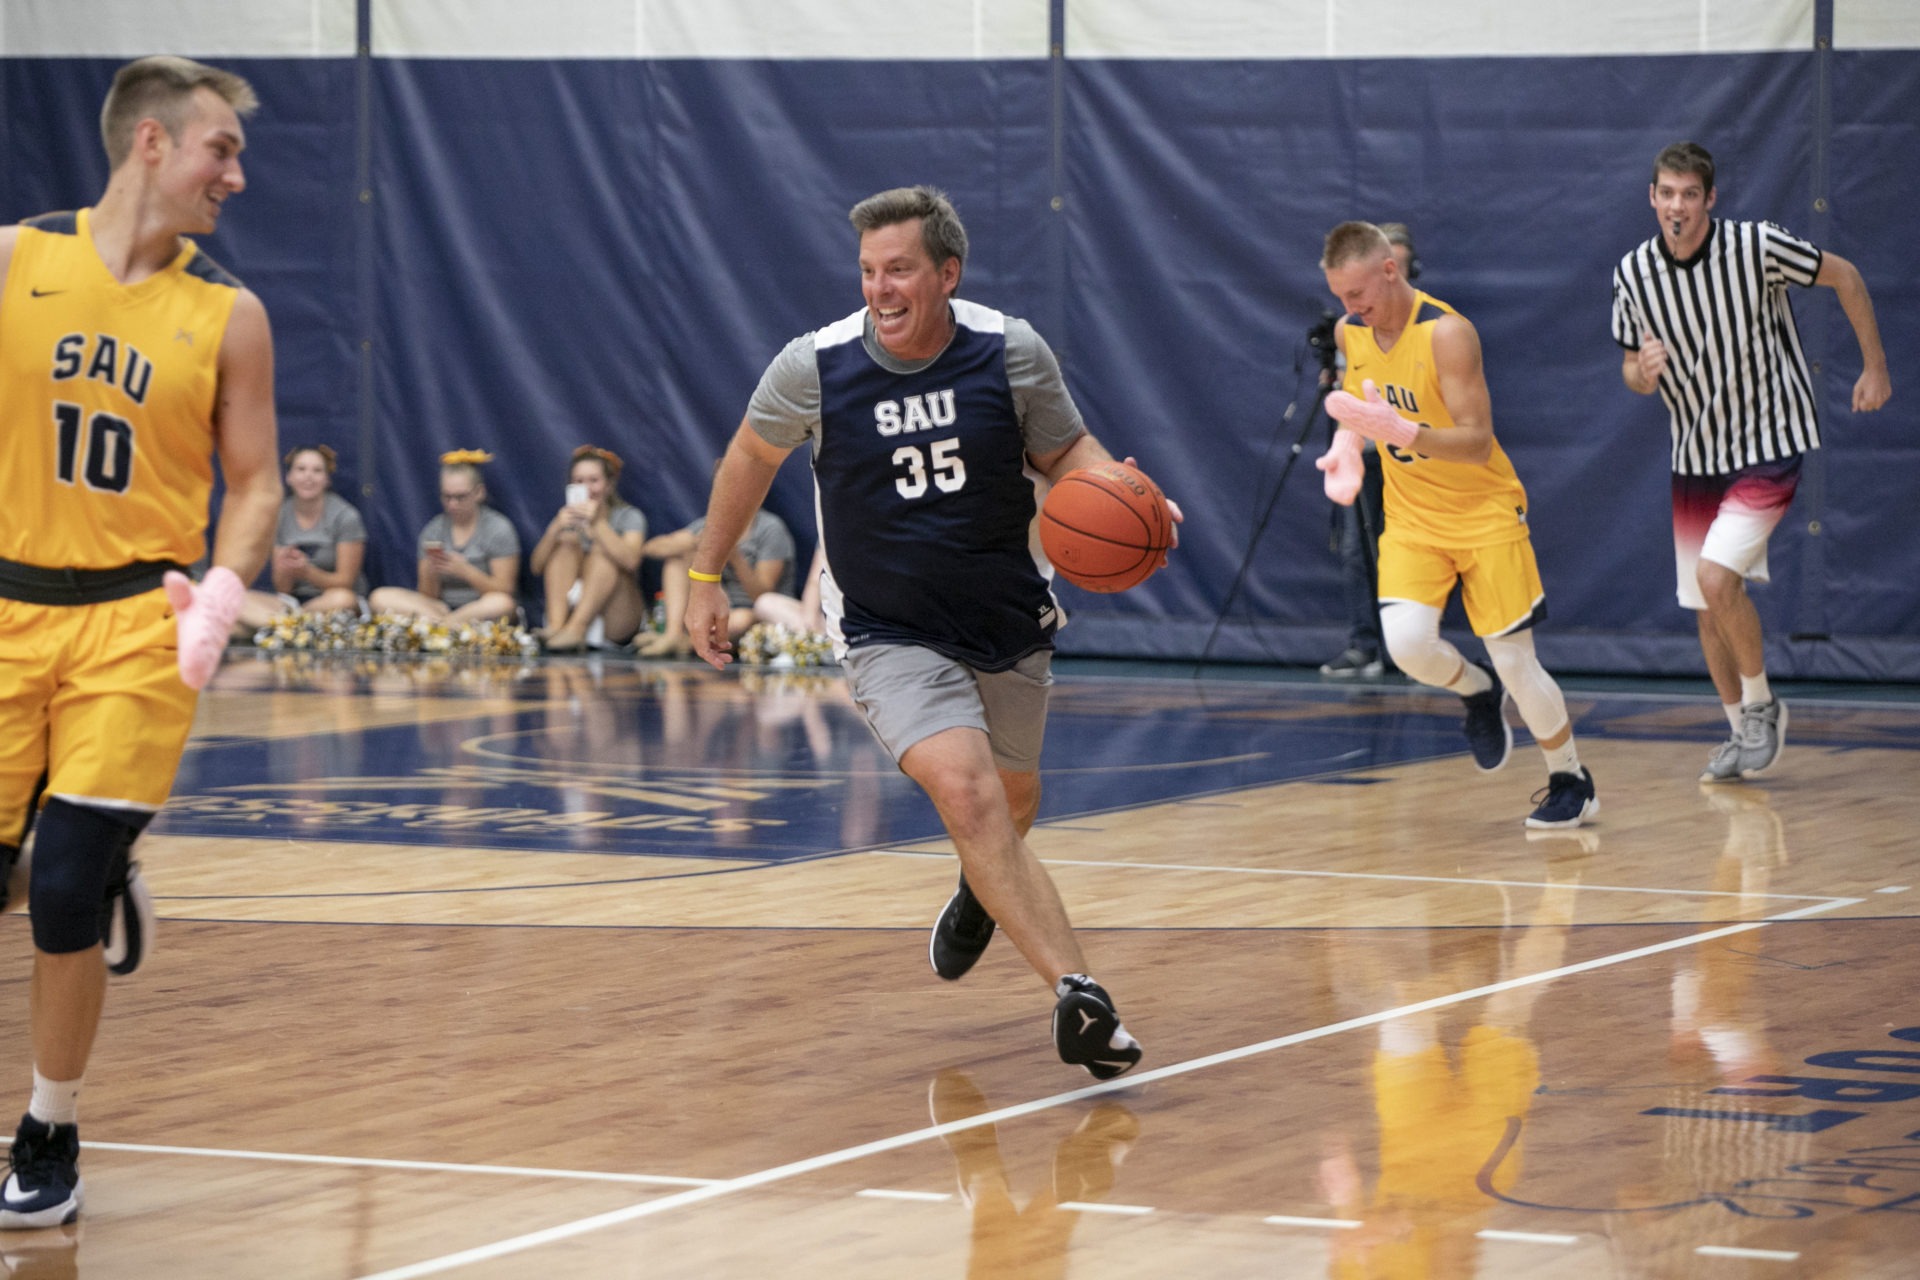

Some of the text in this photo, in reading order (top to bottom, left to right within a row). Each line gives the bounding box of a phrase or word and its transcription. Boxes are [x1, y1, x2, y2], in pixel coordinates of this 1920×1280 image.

[51, 332, 153, 406] SAU
[1375, 383, 1420, 413] AU
[874, 388, 957, 437] SAU
[54, 400, 134, 494] 10
[891, 437, 967, 499] 35
